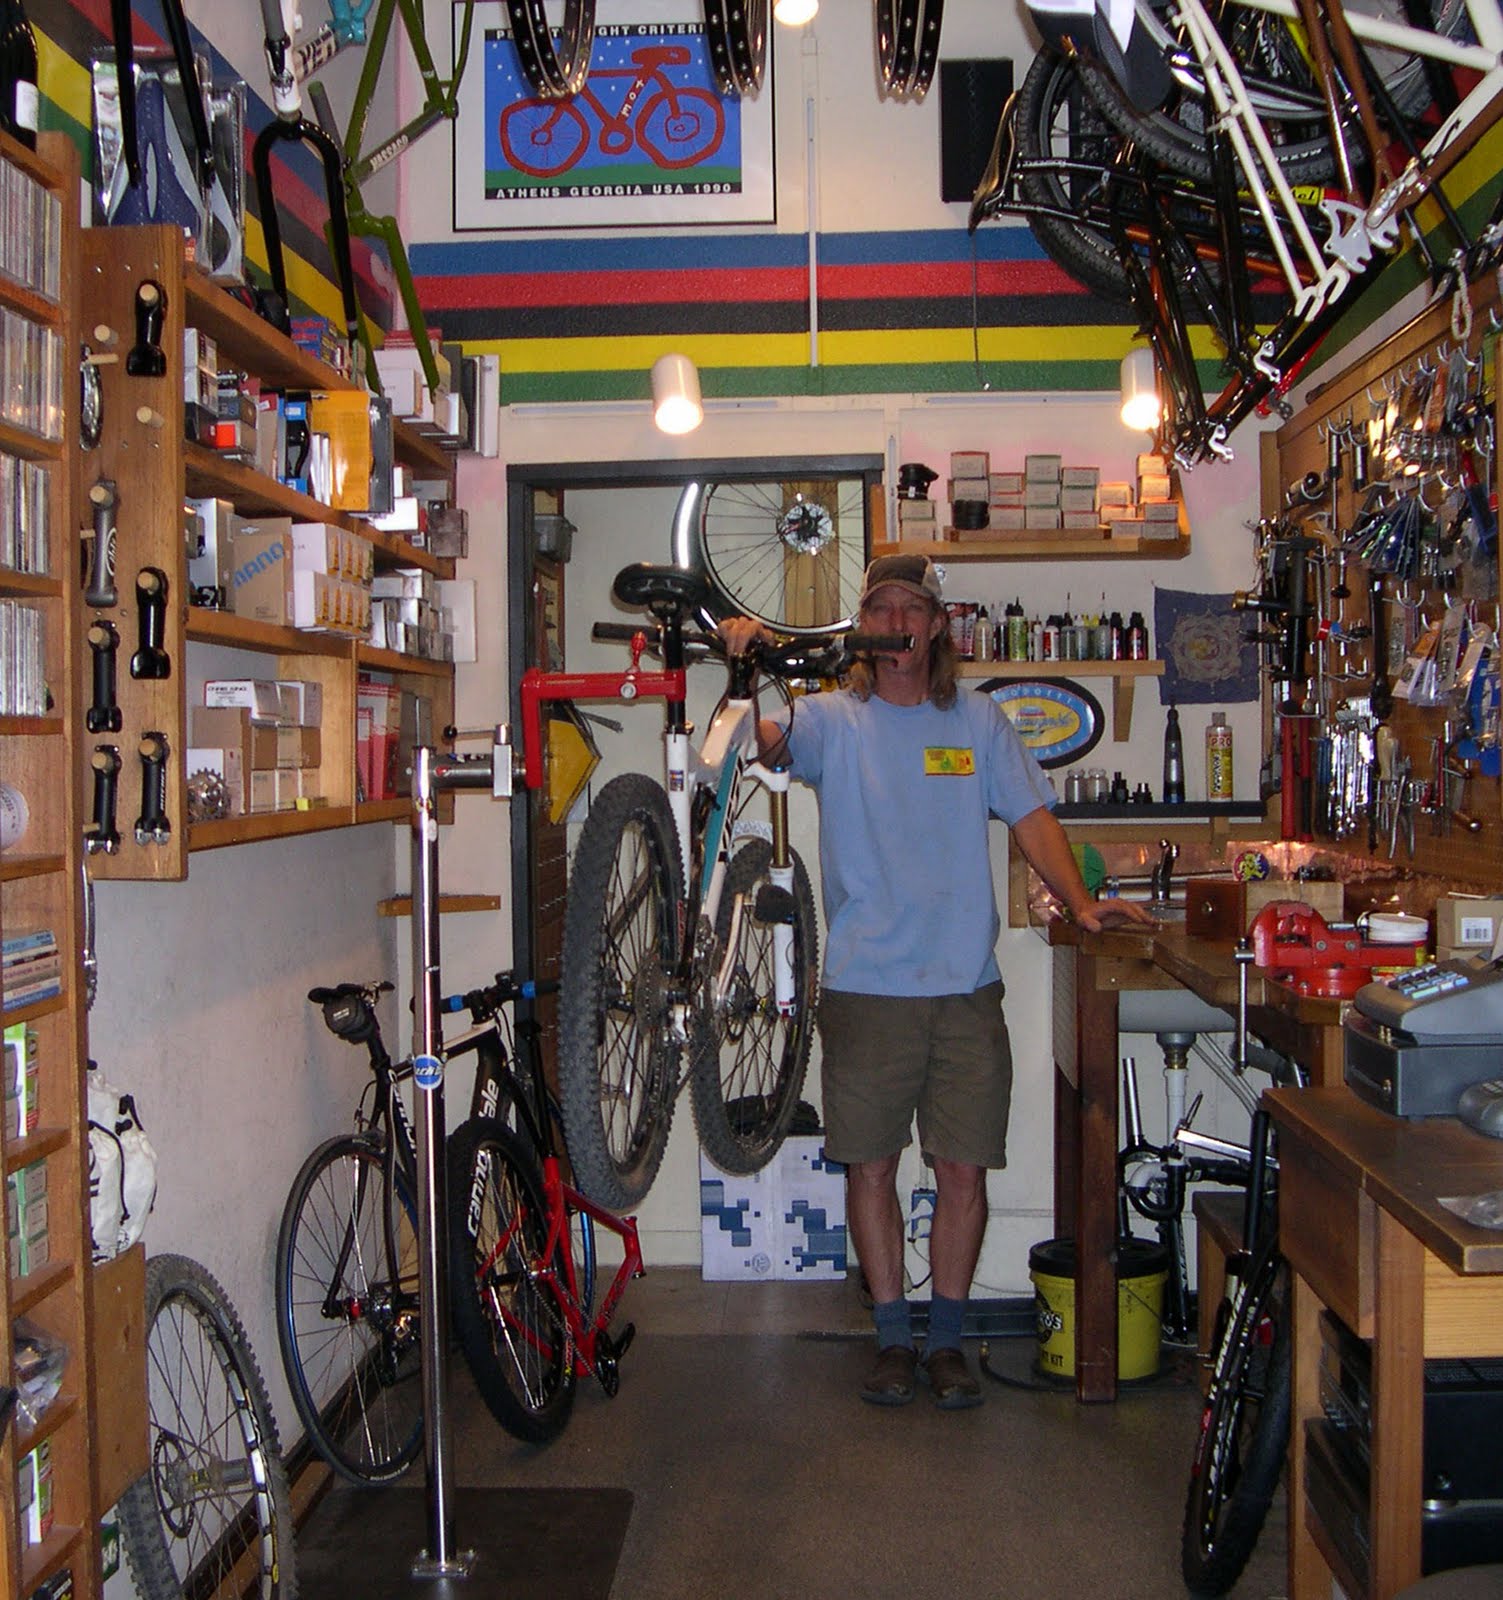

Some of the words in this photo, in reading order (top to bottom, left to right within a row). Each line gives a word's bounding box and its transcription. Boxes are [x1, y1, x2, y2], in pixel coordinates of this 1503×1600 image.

[638, 24, 704, 35] CRITERI
[496, 187, 560, 199] ATHENS
[570, 185, 643, 197] GEORGIA
[652, 184, 684, 195] USA
[694, 183, 732, 194] 1990
[1210, 736, 1231, 748] PRO
